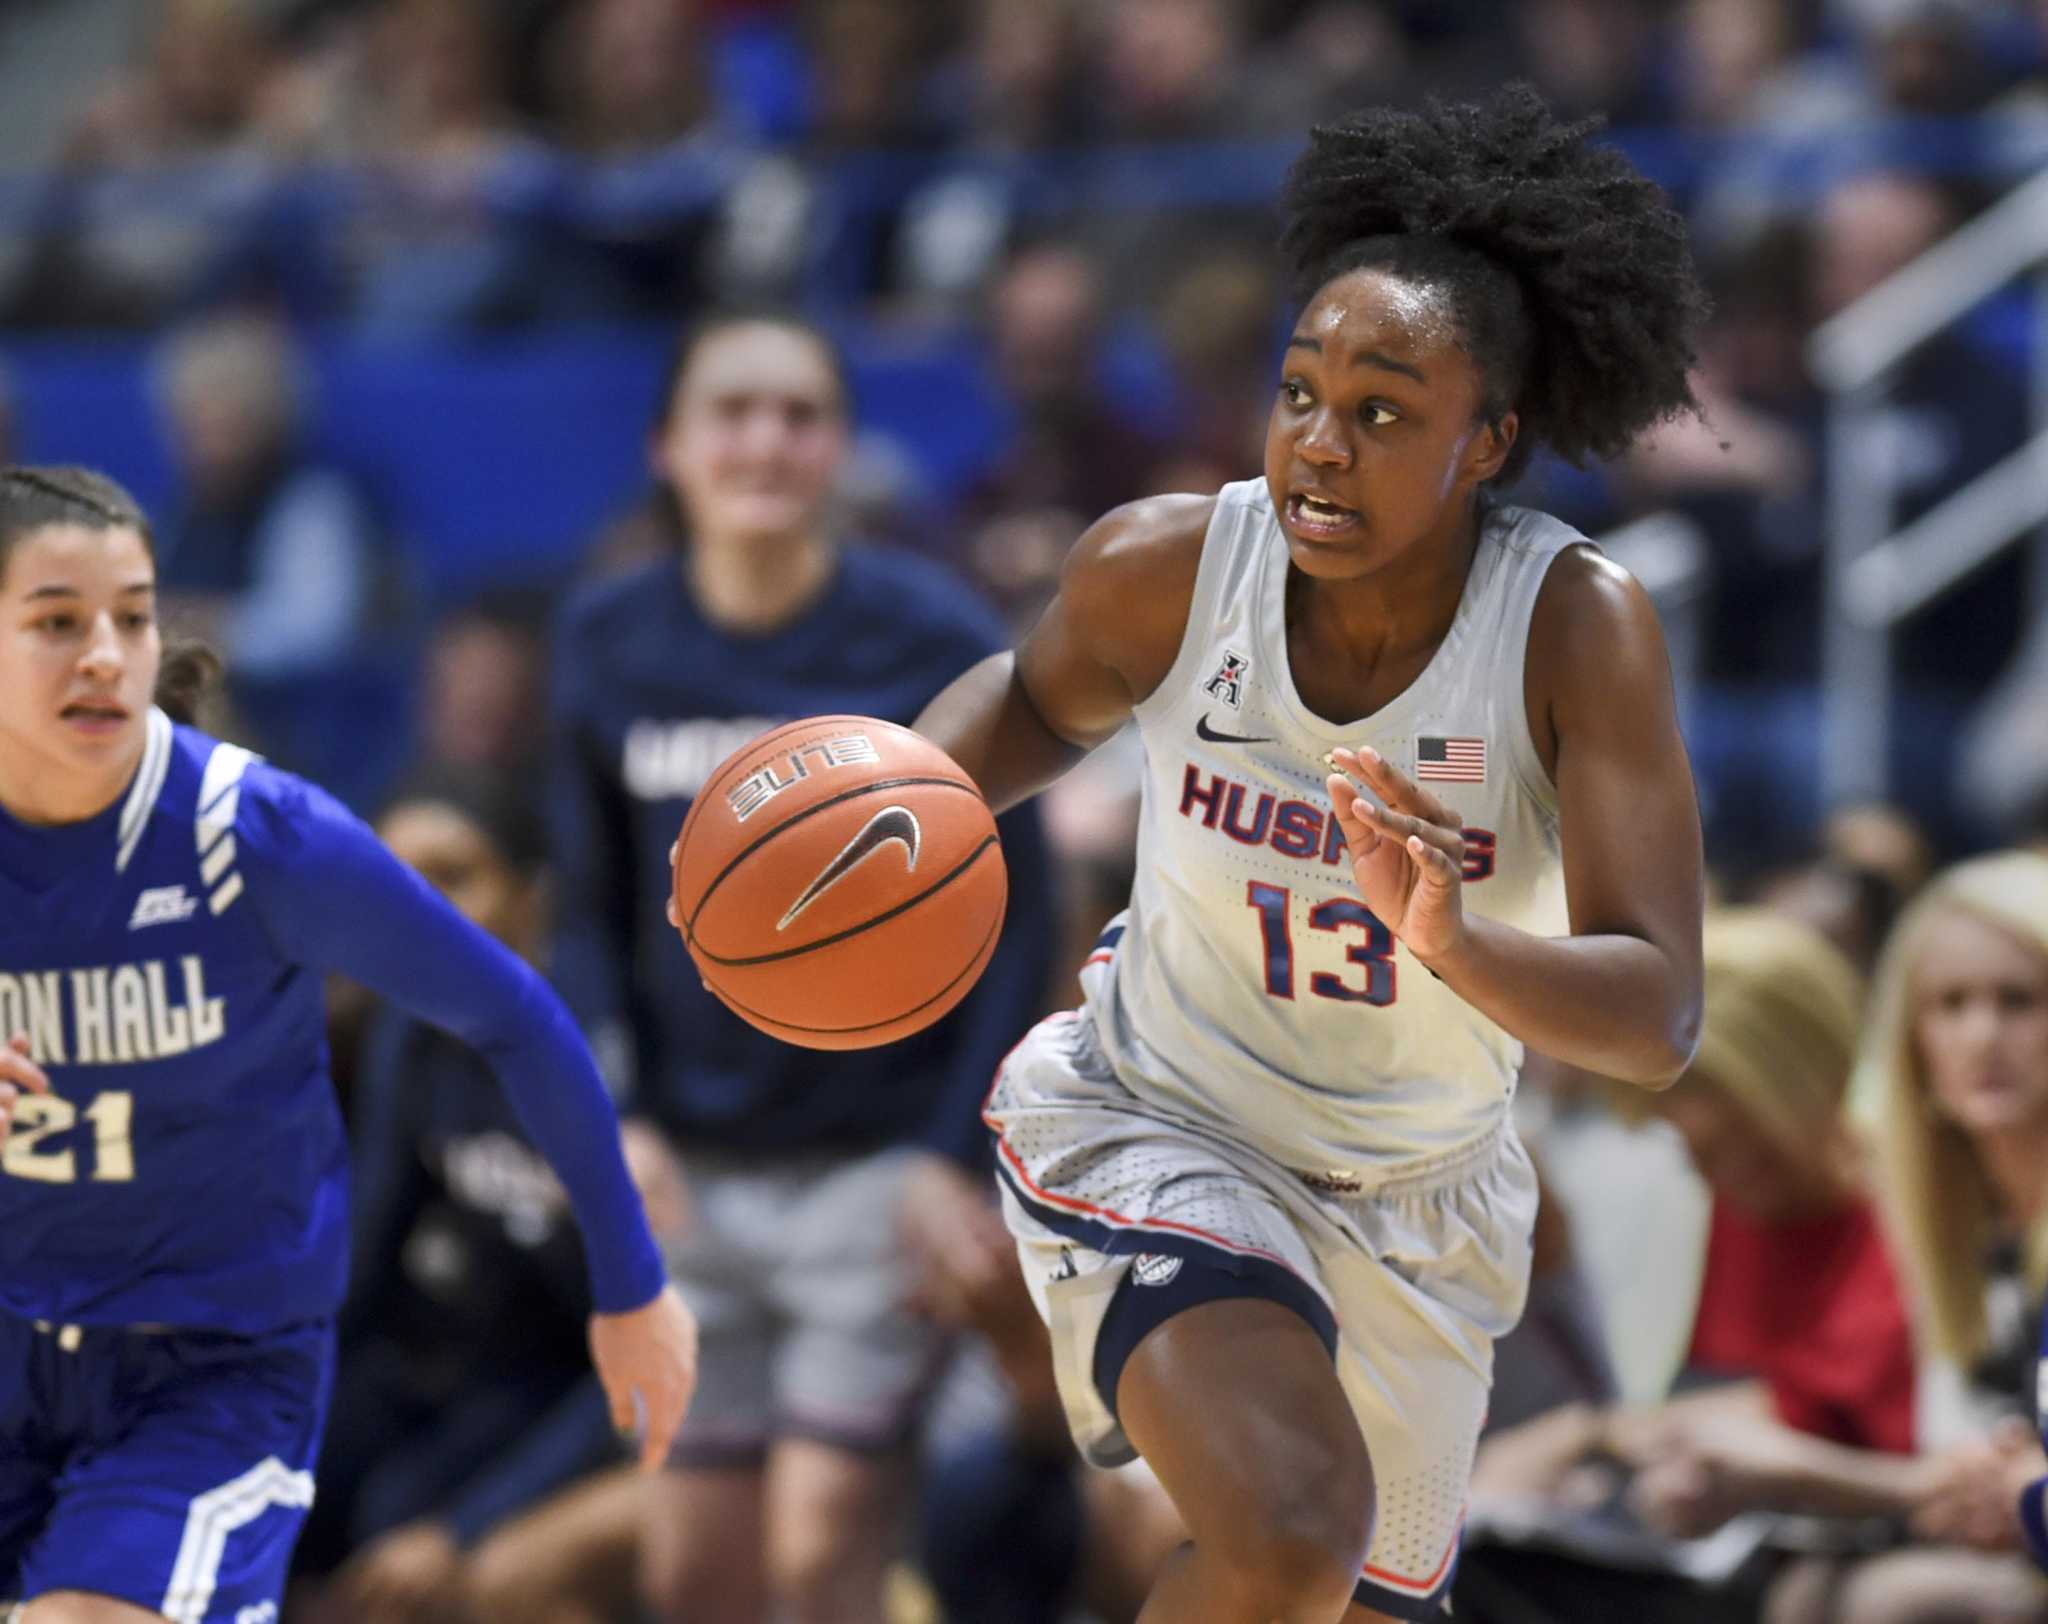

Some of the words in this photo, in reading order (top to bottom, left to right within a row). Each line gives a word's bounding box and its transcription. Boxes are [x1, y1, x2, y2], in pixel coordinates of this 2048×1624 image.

[727, 735, 880, 823] ELITE
[1178, 762, 1497, 882] HUSS
[1247, 879, 1398, 1008] 13
[70, 954, 227, 1065] HALL
[1, 1090, 135, 1184] 21
